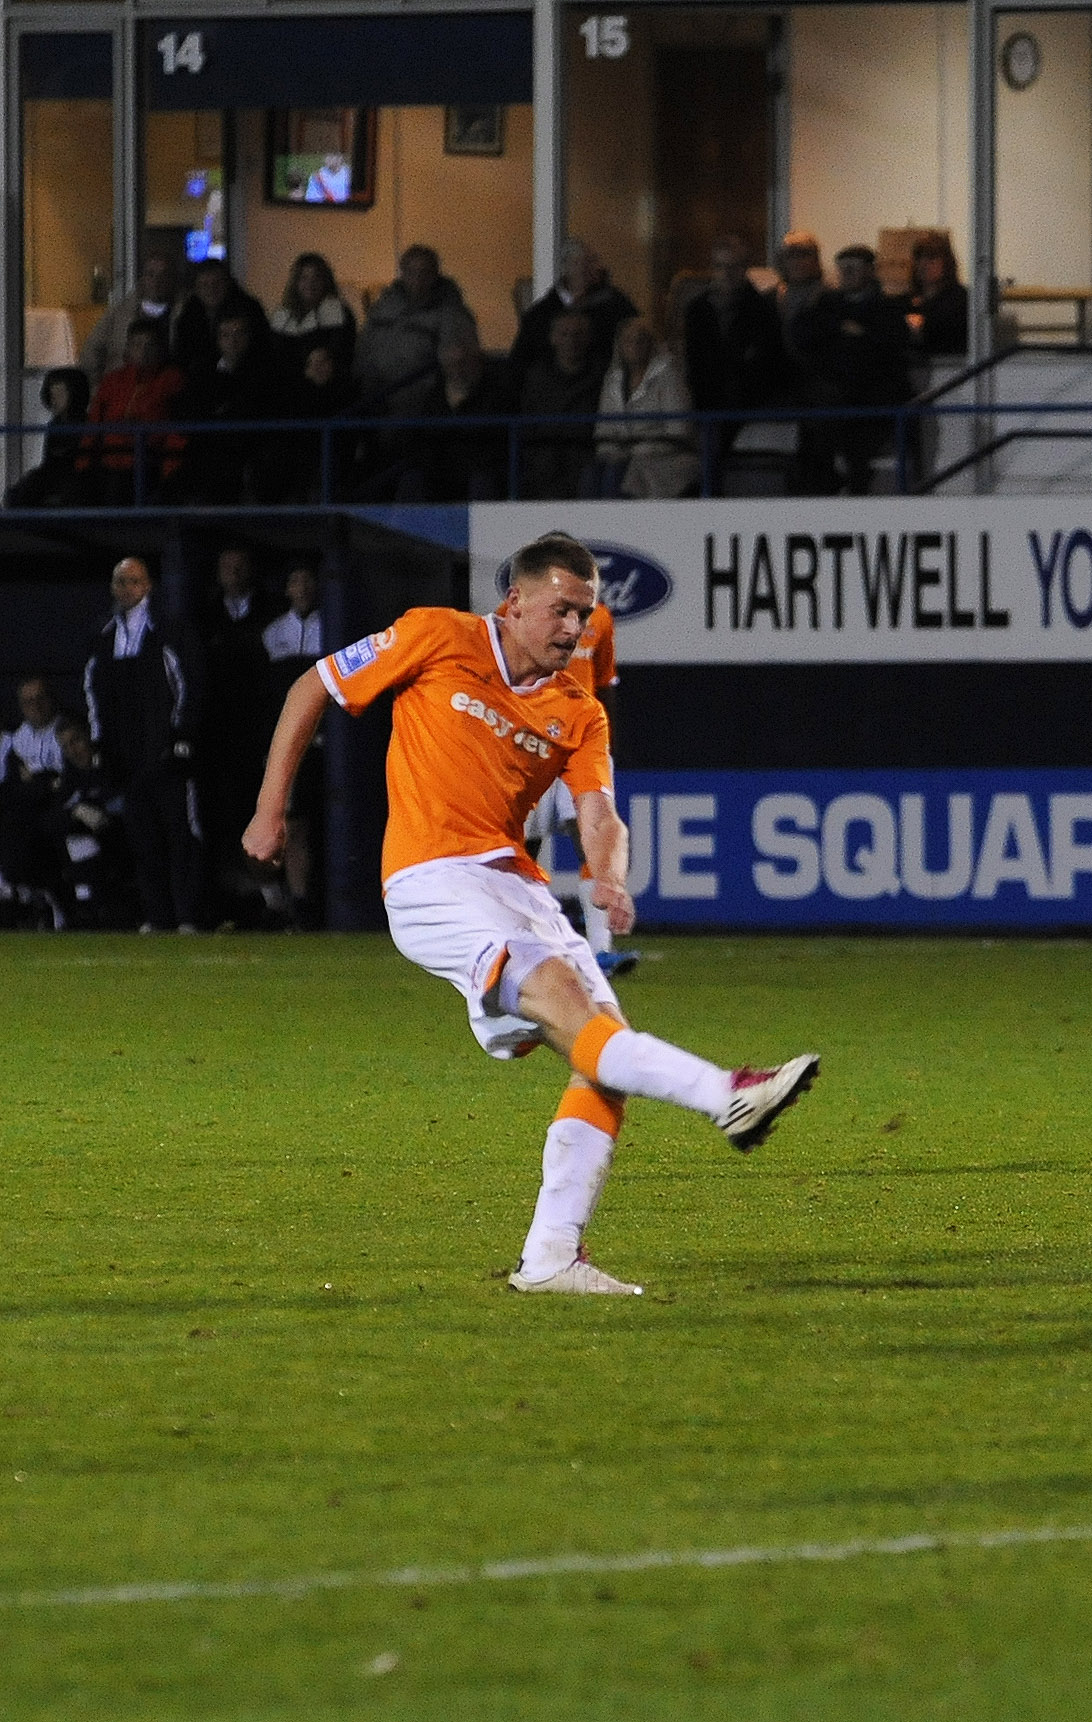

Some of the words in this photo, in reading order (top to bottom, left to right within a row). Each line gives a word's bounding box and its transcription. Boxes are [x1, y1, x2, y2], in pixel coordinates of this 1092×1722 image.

[157, 32, 205, 76] 14
[579, 15, 631, 58] 15
[703, 531, 1011, 631] HARTWELL
[538, 794, 718, 898] LUE
